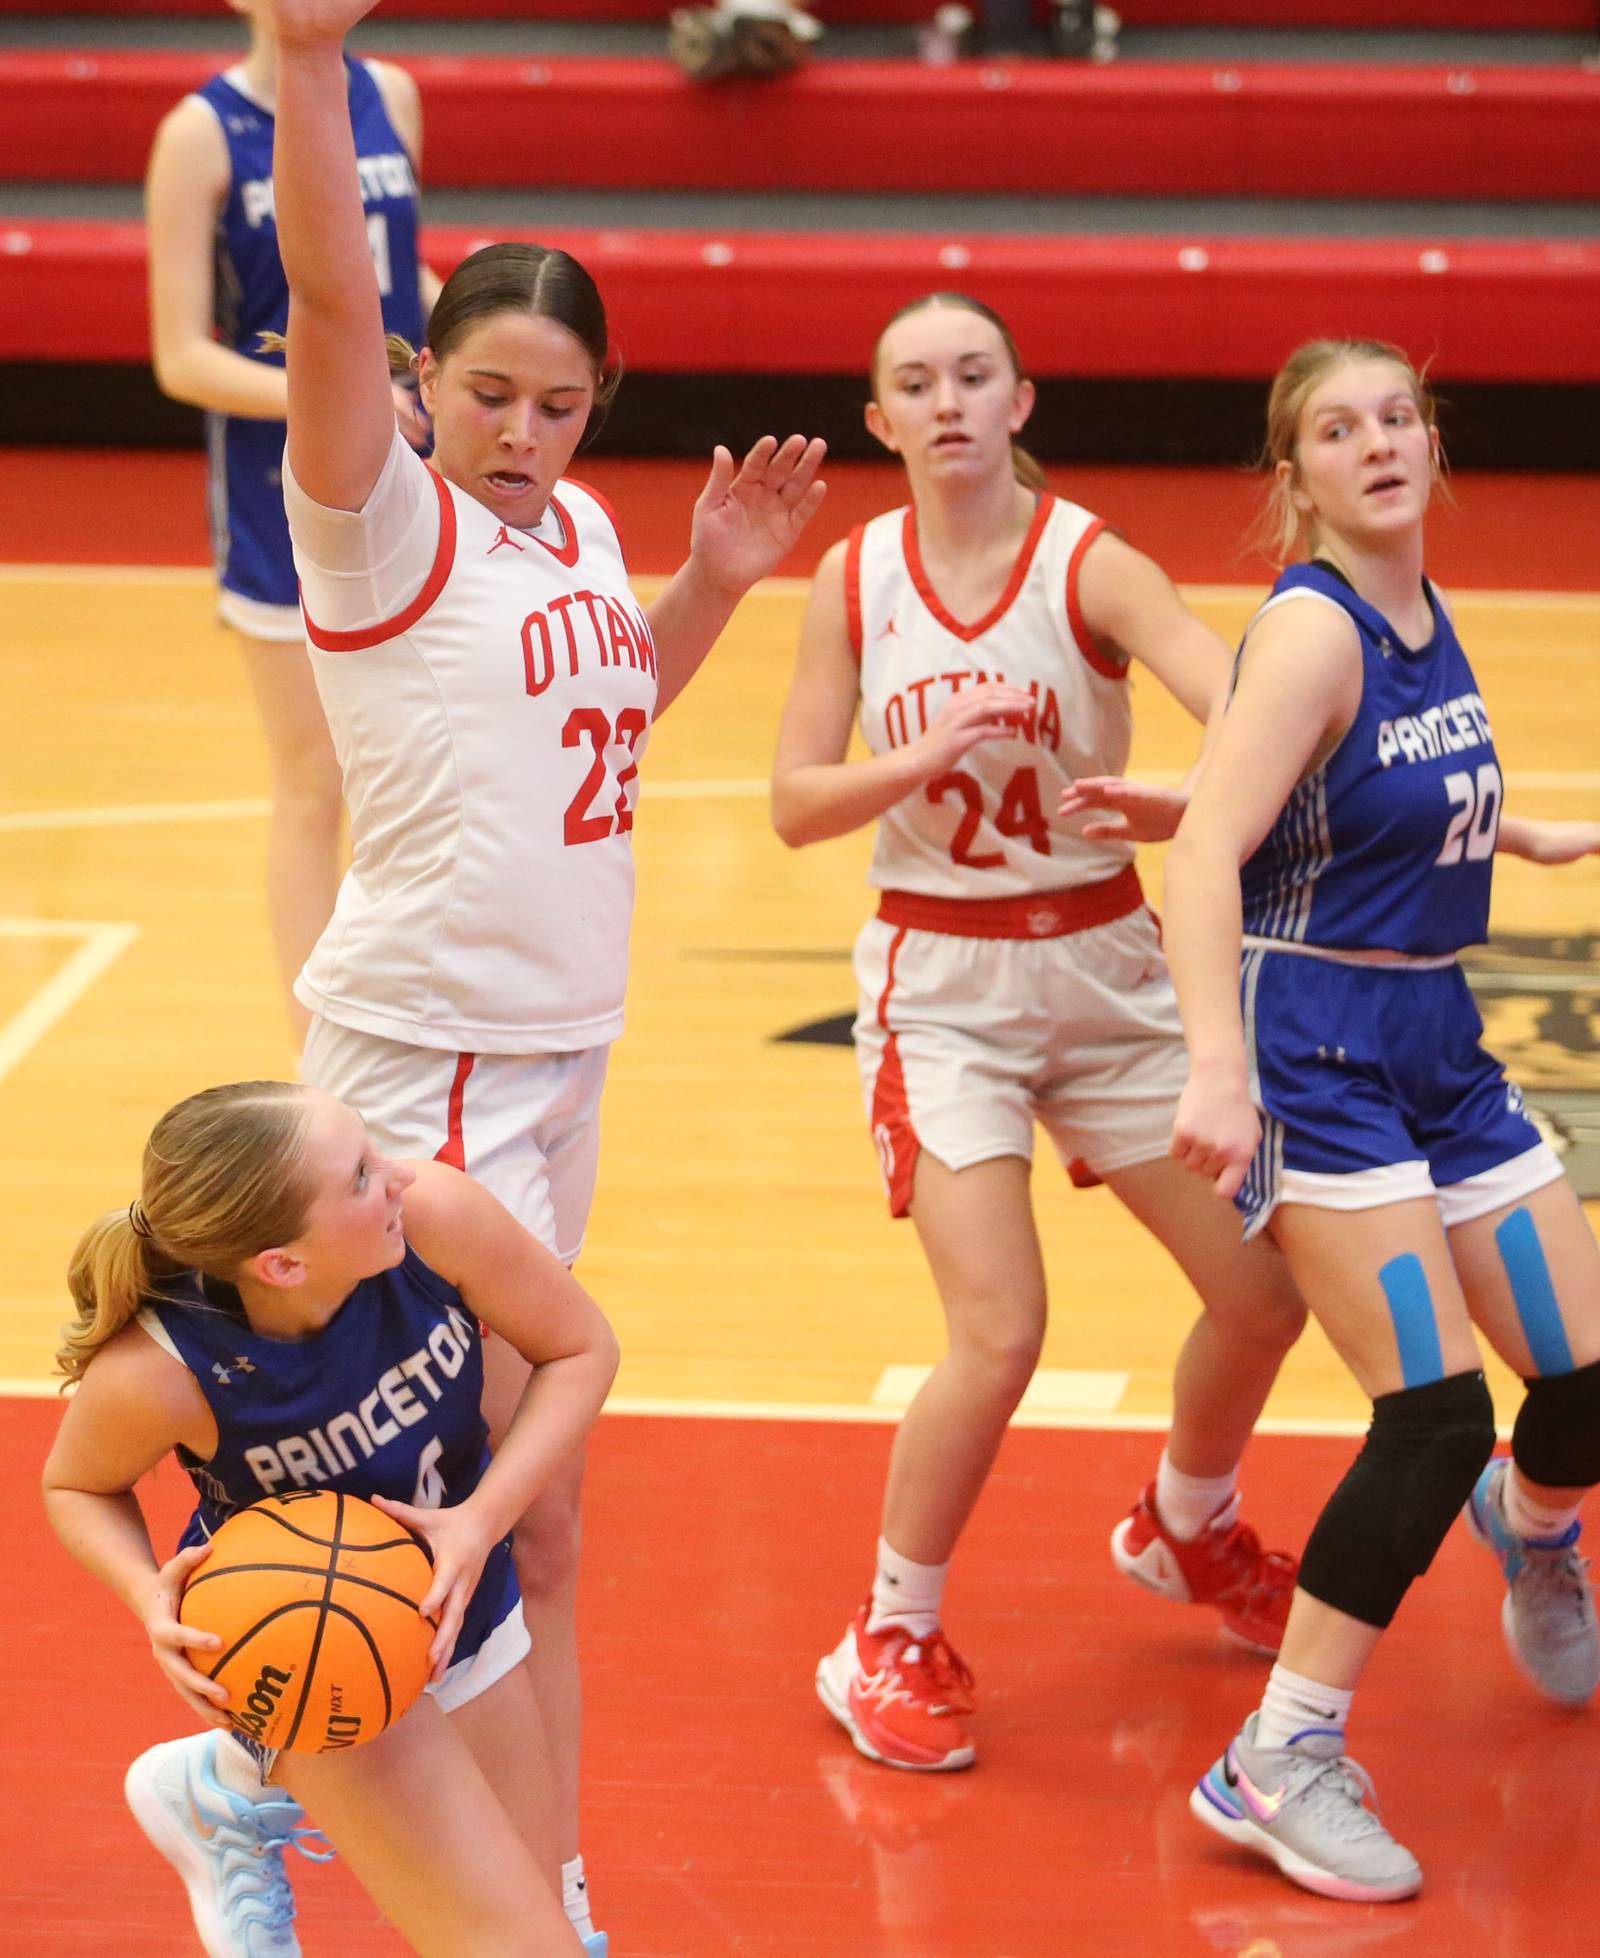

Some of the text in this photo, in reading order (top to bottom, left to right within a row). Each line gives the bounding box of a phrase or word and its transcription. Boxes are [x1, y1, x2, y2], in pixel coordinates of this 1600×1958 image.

[520, 589, 658, 697] OTTAW
[561, 707, 647, 846] 22
[926, 766, 1052, 869] 24
[1433, 762, 1501, 867] 20
[331, 1684, 343, 1713] NXT
